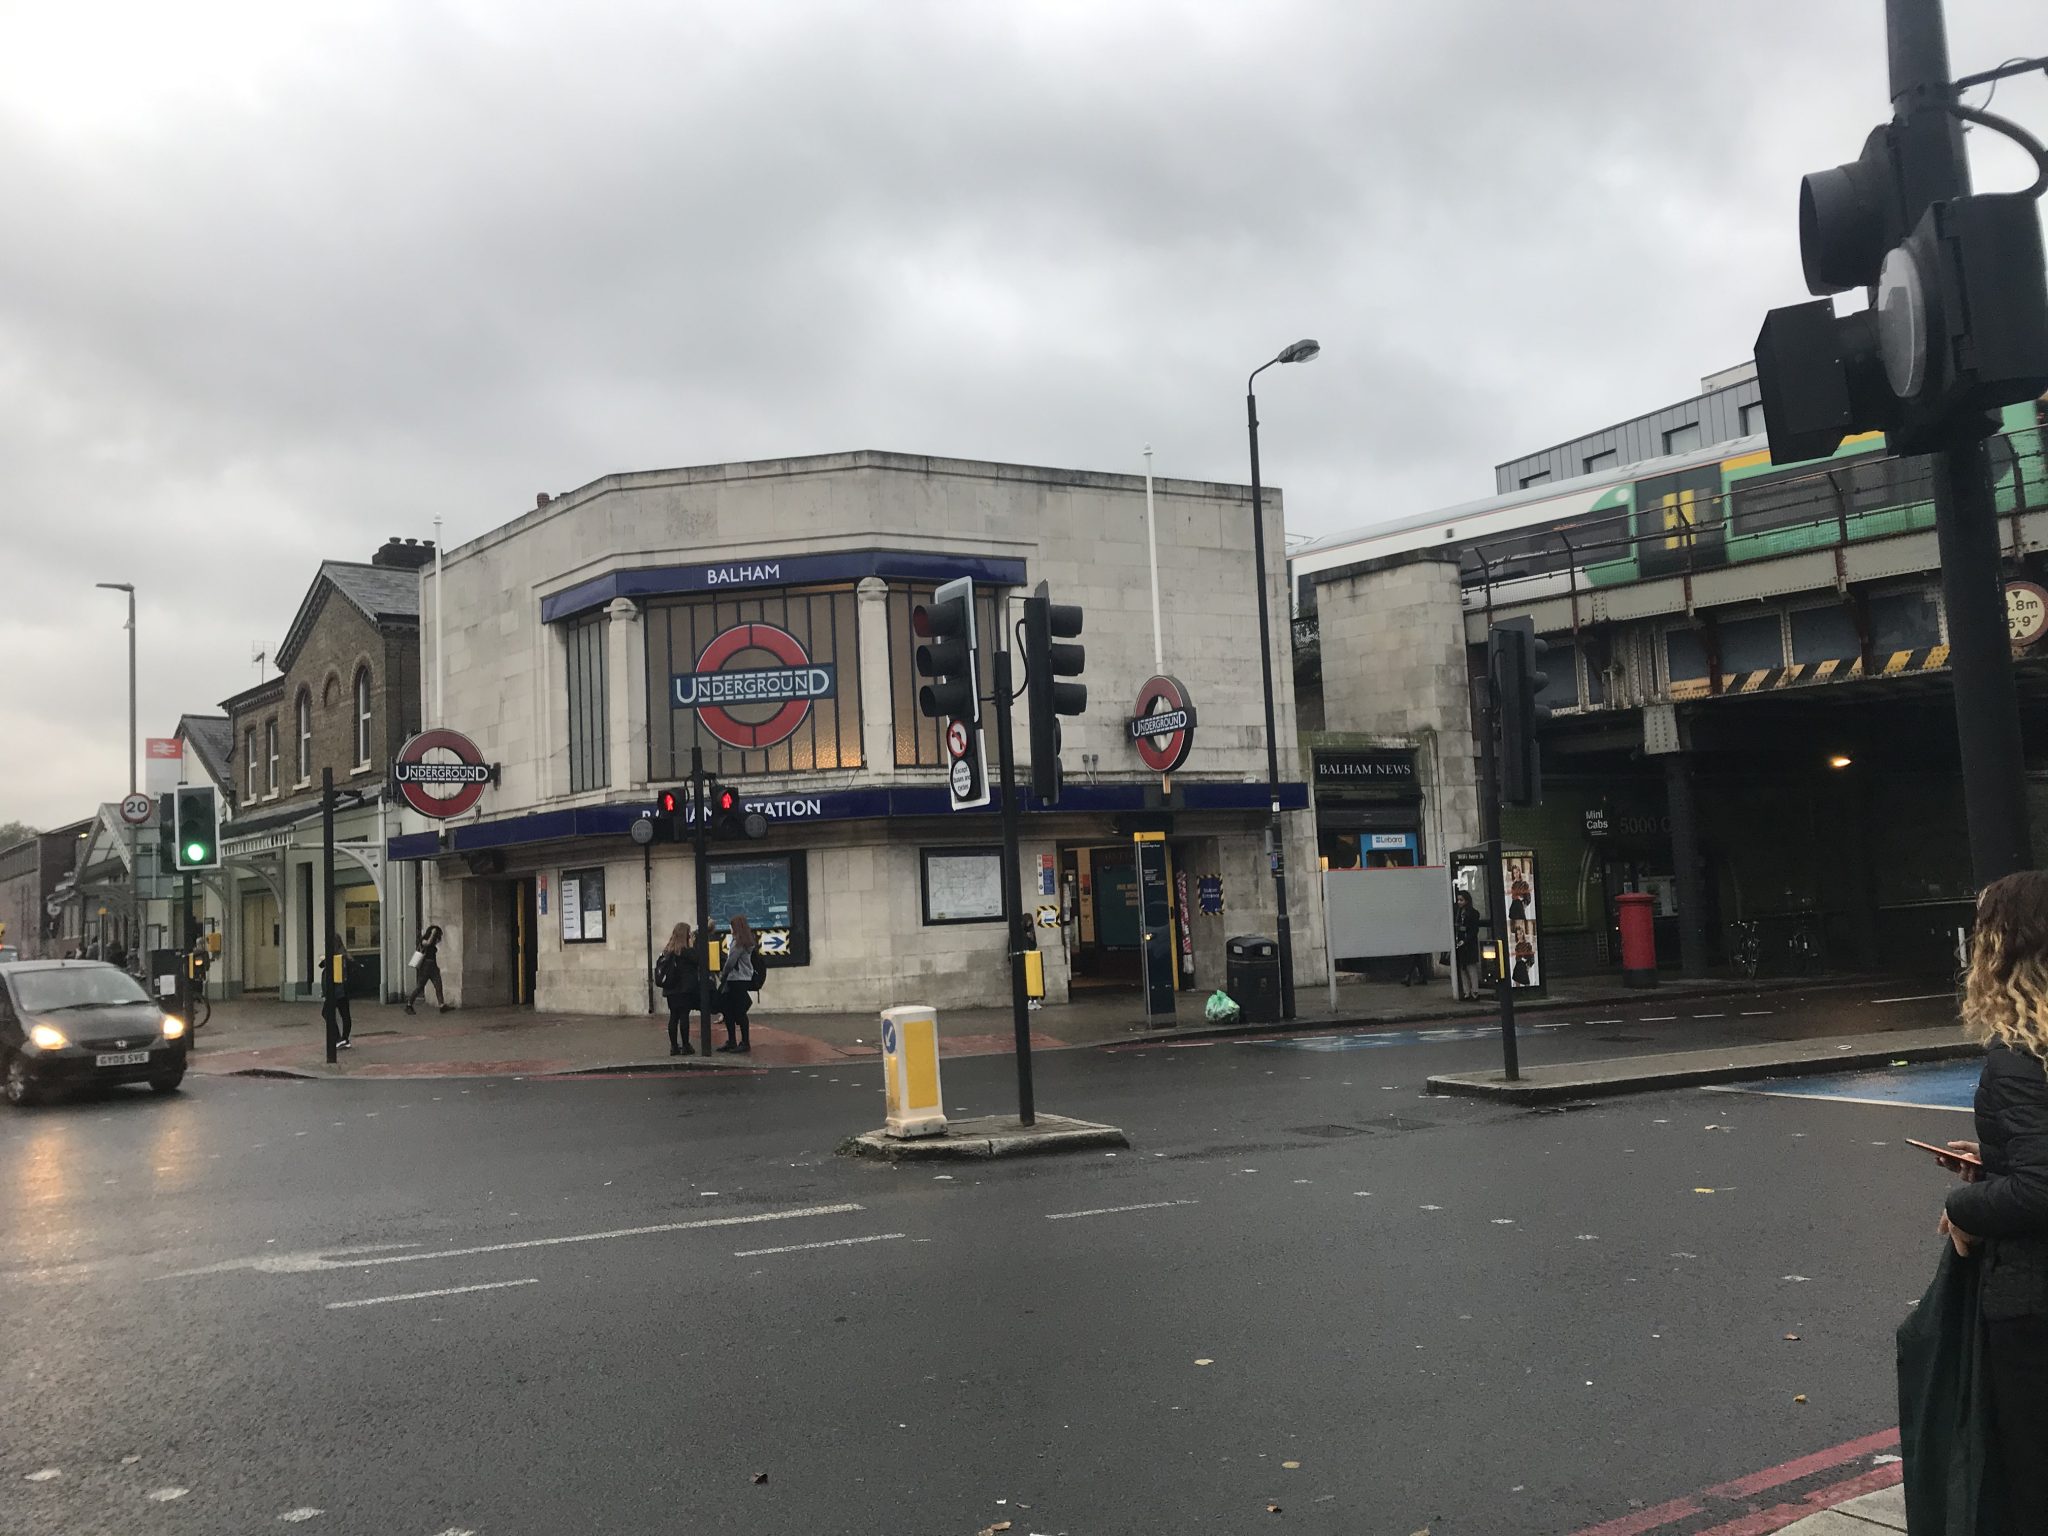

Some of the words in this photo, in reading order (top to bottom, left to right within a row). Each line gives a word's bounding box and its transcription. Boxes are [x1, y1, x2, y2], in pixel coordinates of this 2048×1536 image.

[707, 564, 780, 584] BALHAM
[2007, 600, 2038, 611] .8m
[676, 669, 830, 704] UNDERGROUND
[1132, 710, 1188, 738] UNDERGROUND
[395, 764, 489, 782] UNDERGROUND
[1319, 763, 1372, 775] BALHAM
[1376, 763, 1411, 775] NEWS
[126, 801, 148, 813] 20
[744, 799, 822, 819] STATION
[1585, 809, 1604, 819] Mini
[1586, 819, 1609, 829] Cabs
